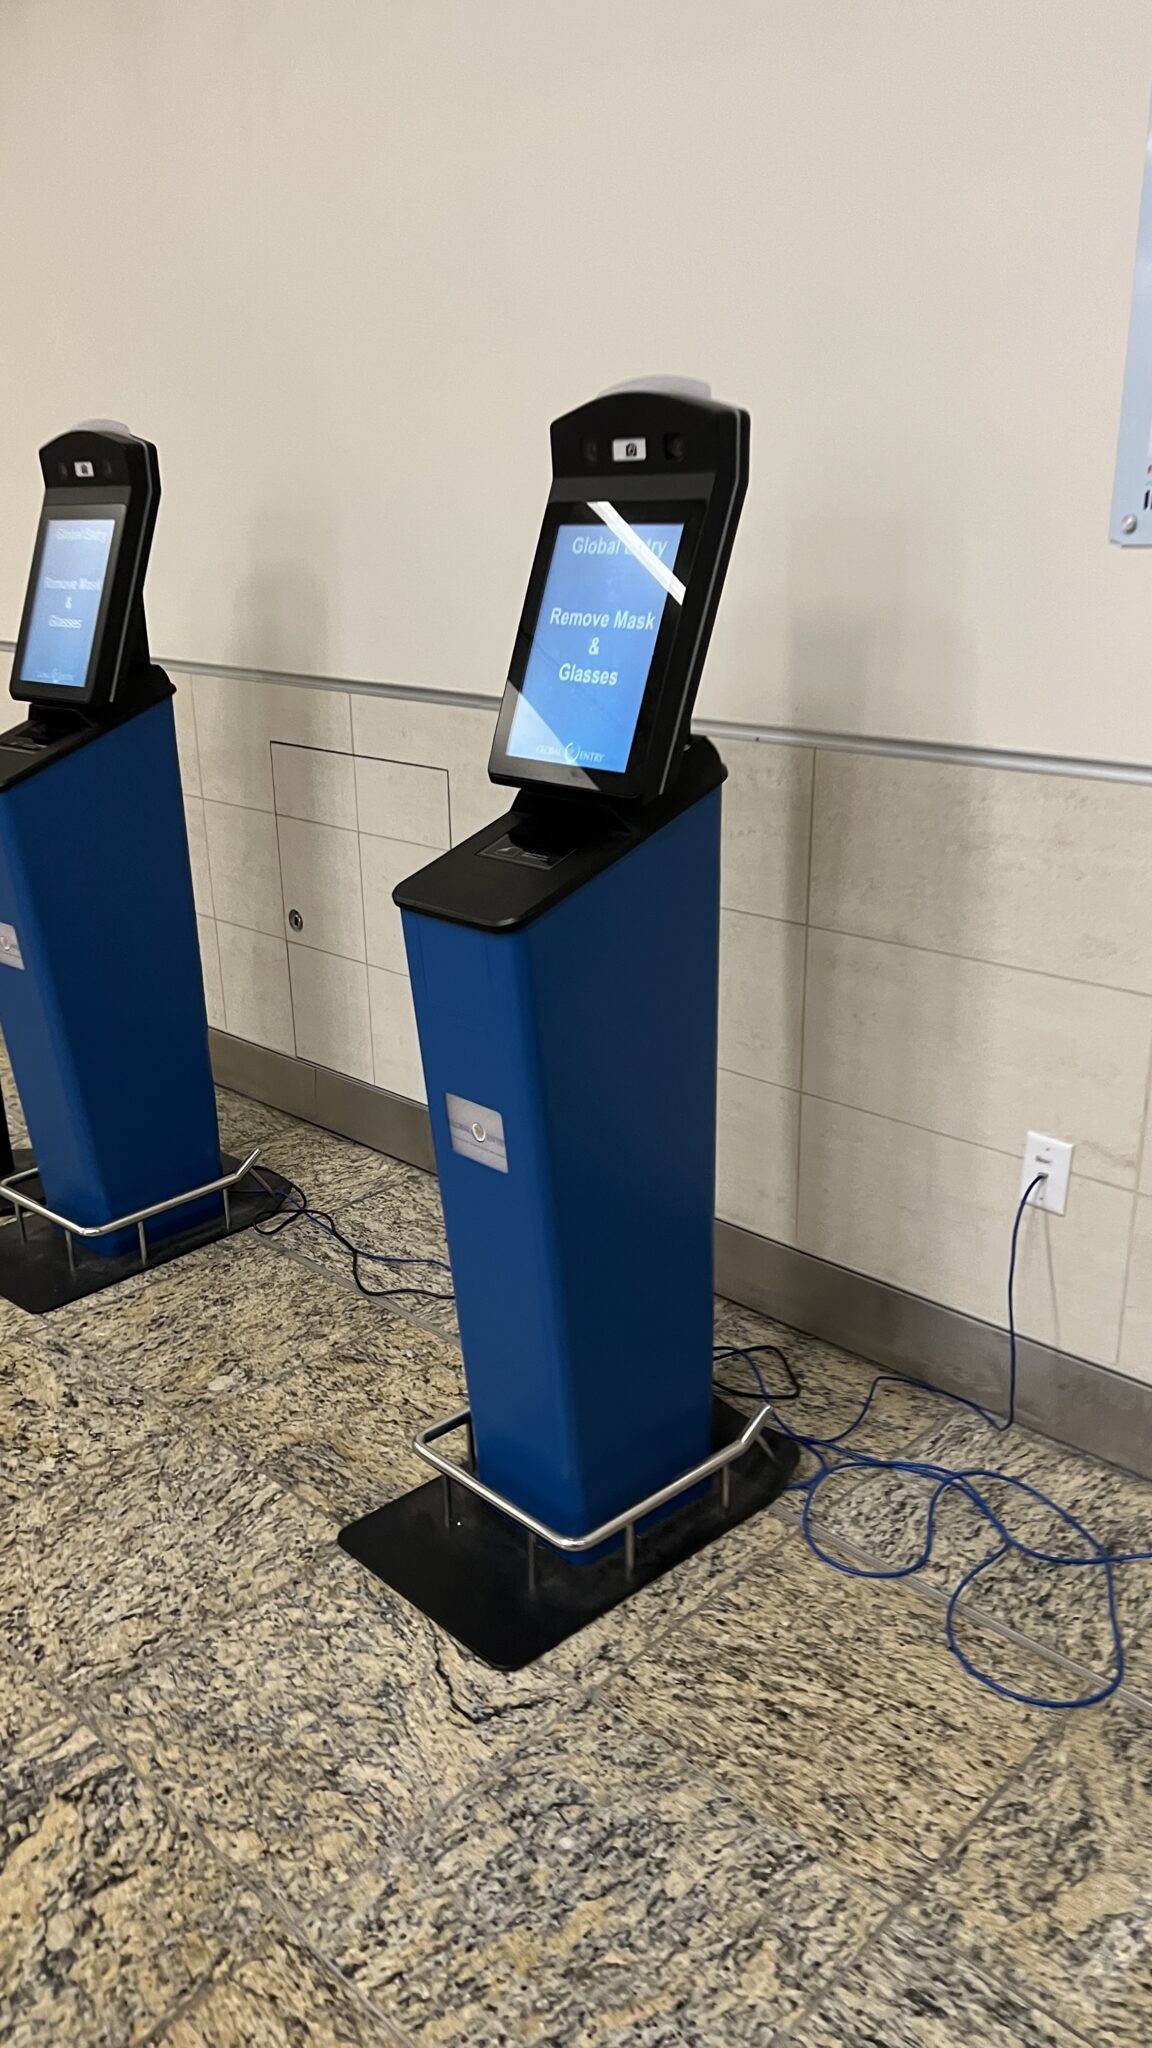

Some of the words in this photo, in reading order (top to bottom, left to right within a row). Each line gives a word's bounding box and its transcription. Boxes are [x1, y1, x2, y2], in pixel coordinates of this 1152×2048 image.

[572, 536, 621, 556] Global
[549, 606, 610, 628] Remove
[613, 609, 656, 631] Mask
[588, 637, 600, 655] &
[558, 662, 619, 687] Glasses
